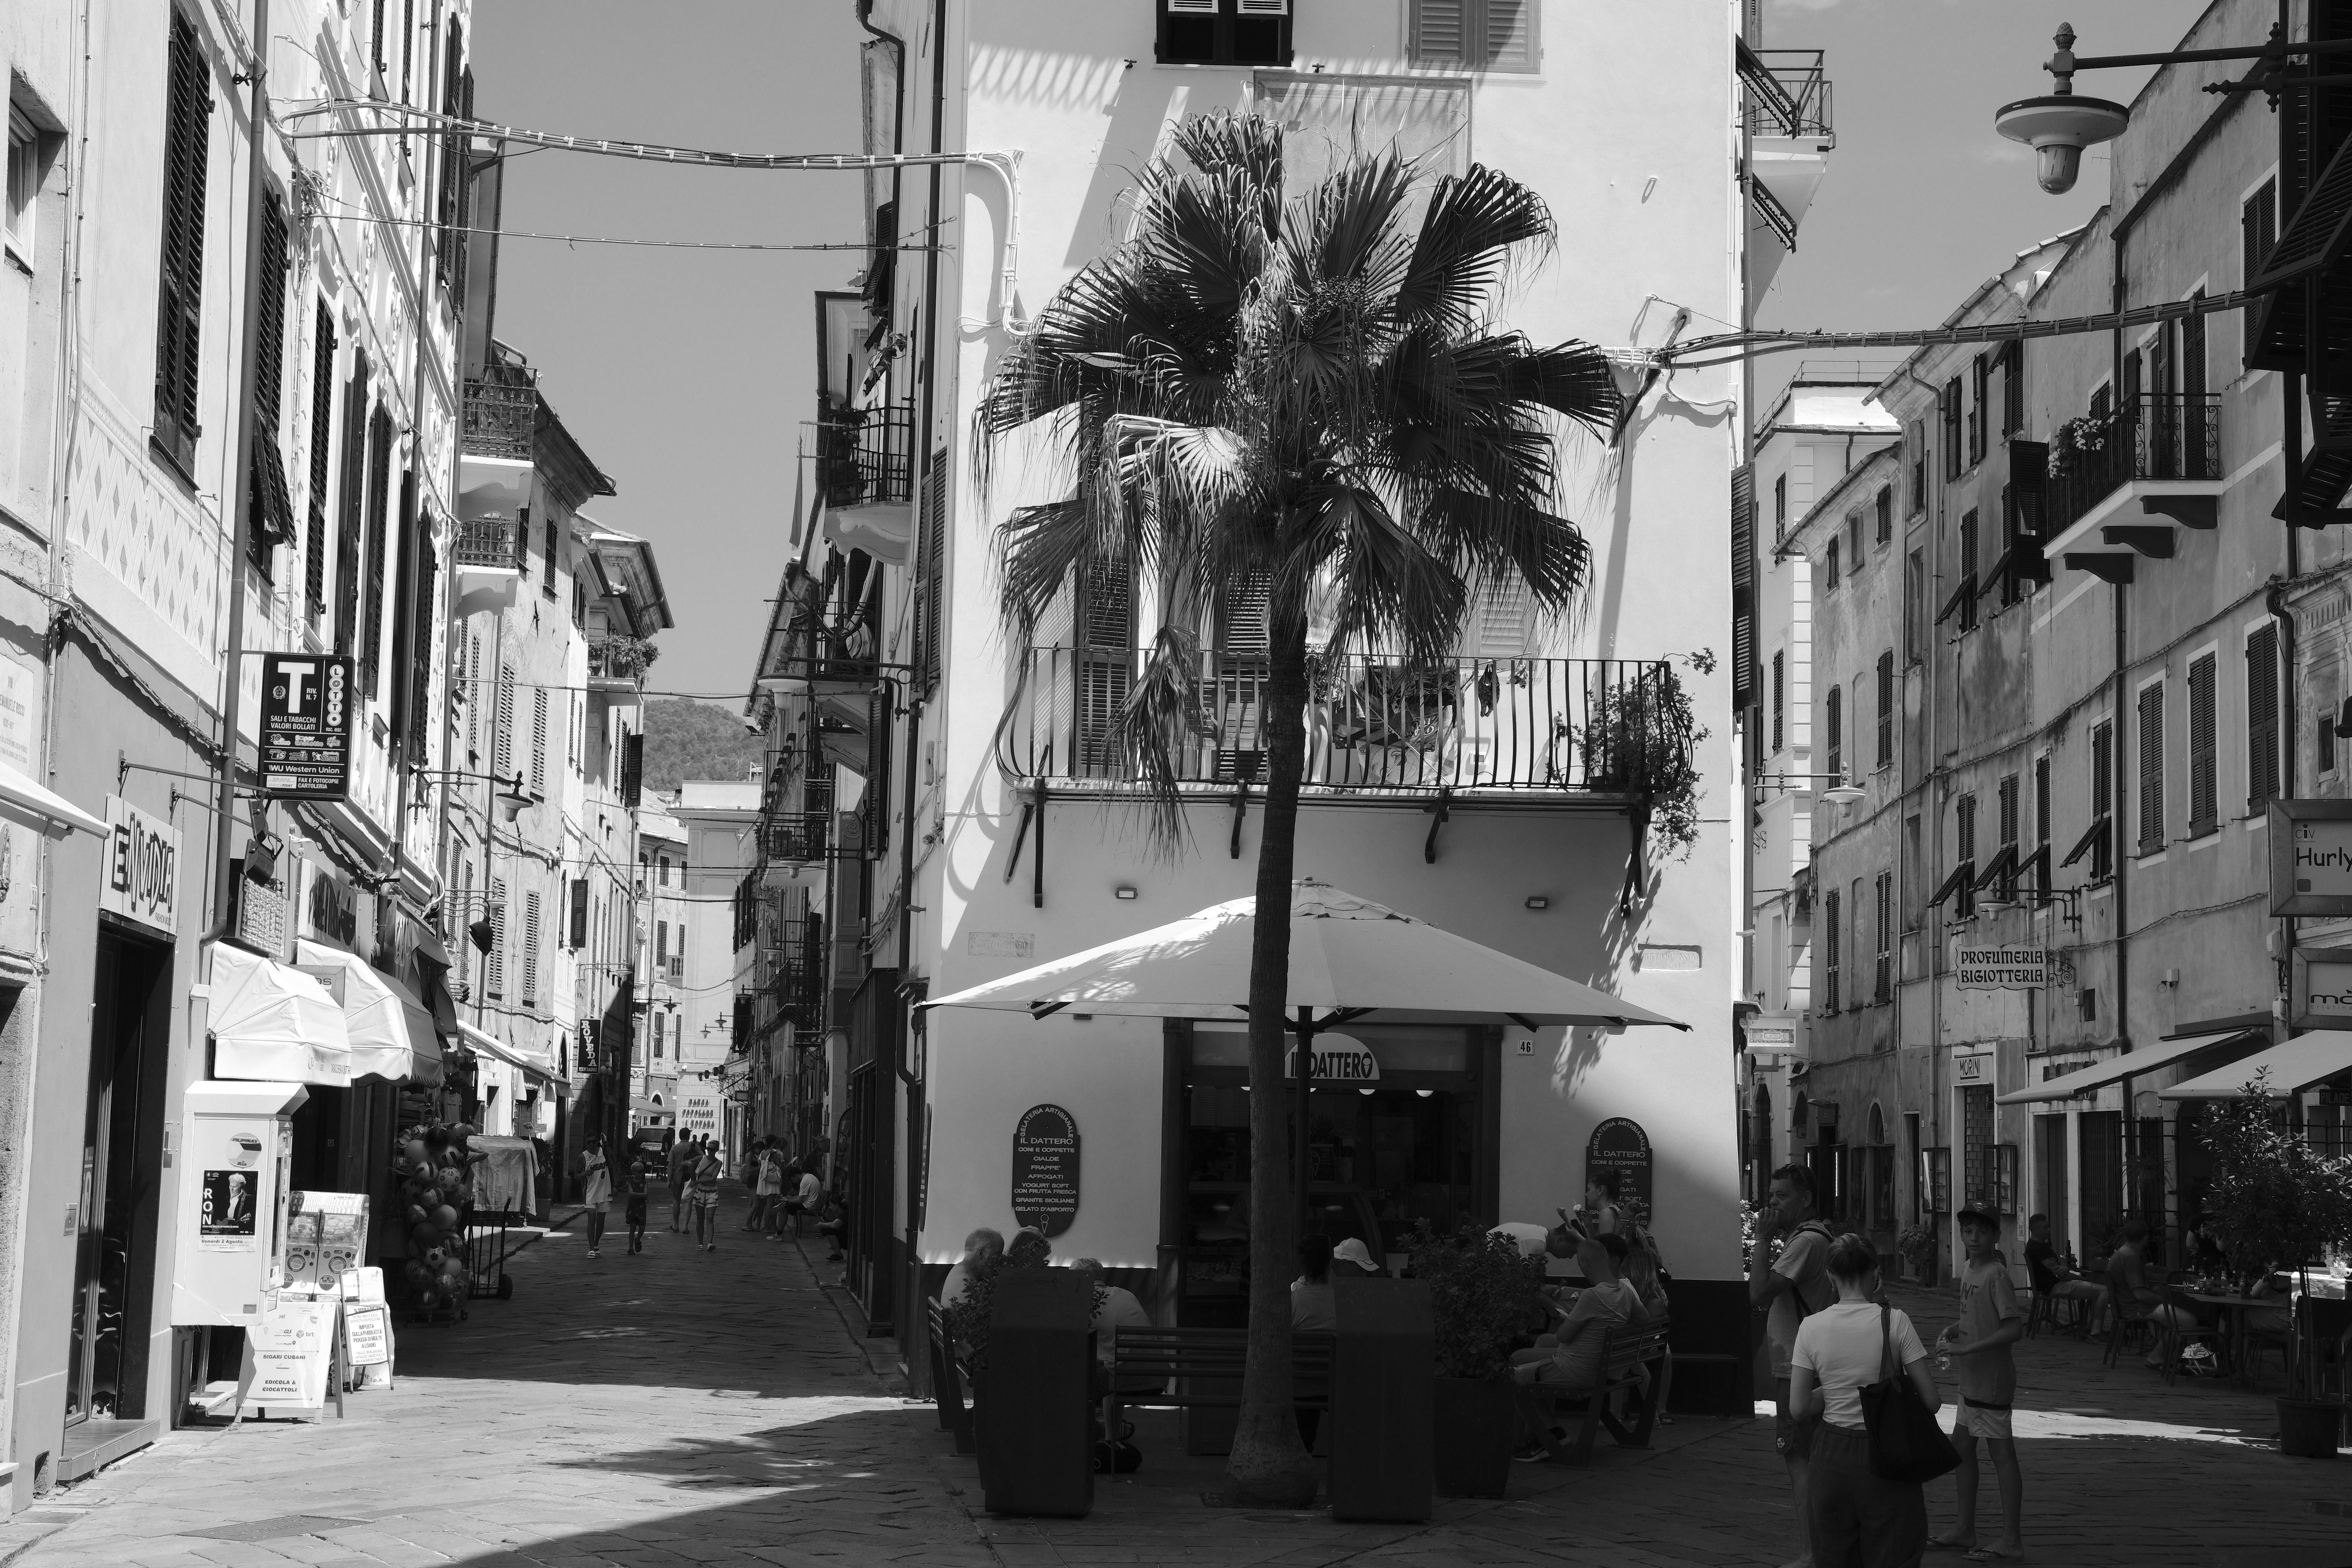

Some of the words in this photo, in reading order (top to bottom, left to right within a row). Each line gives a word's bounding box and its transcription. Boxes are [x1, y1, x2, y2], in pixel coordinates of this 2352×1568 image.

[277, 662, 315, 713] T
[329, 666, 342, 724] LOTTO
[1961, 951, 2043, 964] PROFUMERIA
[1961, 969, 2043, 983] BIGIOTTERIA
[581, 1020, 597, 1066] ROVEDA
[1520, 1041, 1531, 1052] 46
[1960, 1058, 1980, 1076] MORINI
[2321, 1092, 2350, 1104] PILADE
[1020, 1107, 1043, 1137] GELATERIA
[1045, 1107, 1073, 1138] ARTIGIANALE
[1593, 1121, 1616, 1150] GELATERIA
[1617, 1120, 1646, 1152] ARTIGIANALE
[601, 1171, 606, 1179] 6
[203, 1188, 213, 1225] RON
